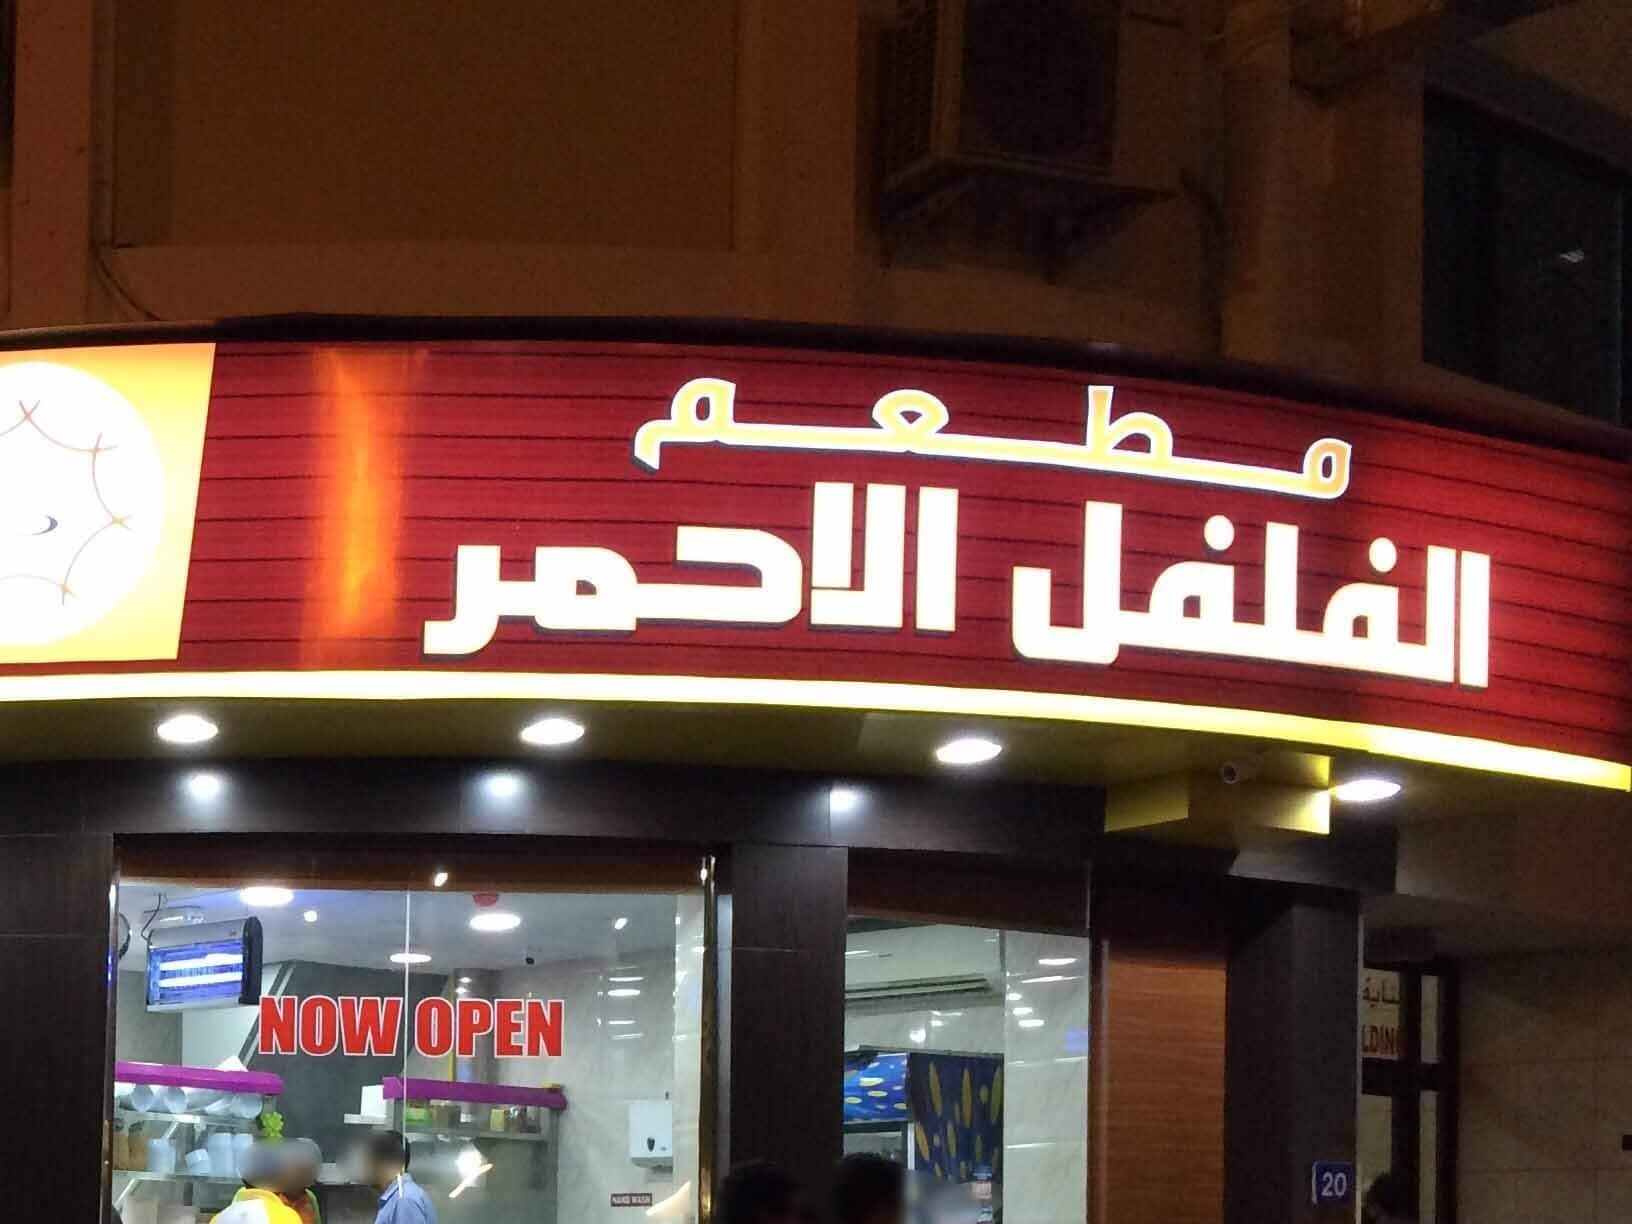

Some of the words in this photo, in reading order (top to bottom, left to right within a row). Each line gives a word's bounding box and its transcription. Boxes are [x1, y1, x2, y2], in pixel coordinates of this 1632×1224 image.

[632, 376, 1353, 499] مطعم
[421, 480, 960, 657] الاحمر
[1011, 500, 1493, 688] الفلفل
[257, 995, 404, 1057] NOW
[415, 997, 565, 1057] OPEN
[1320, 1171, 1348, 1197] 20
